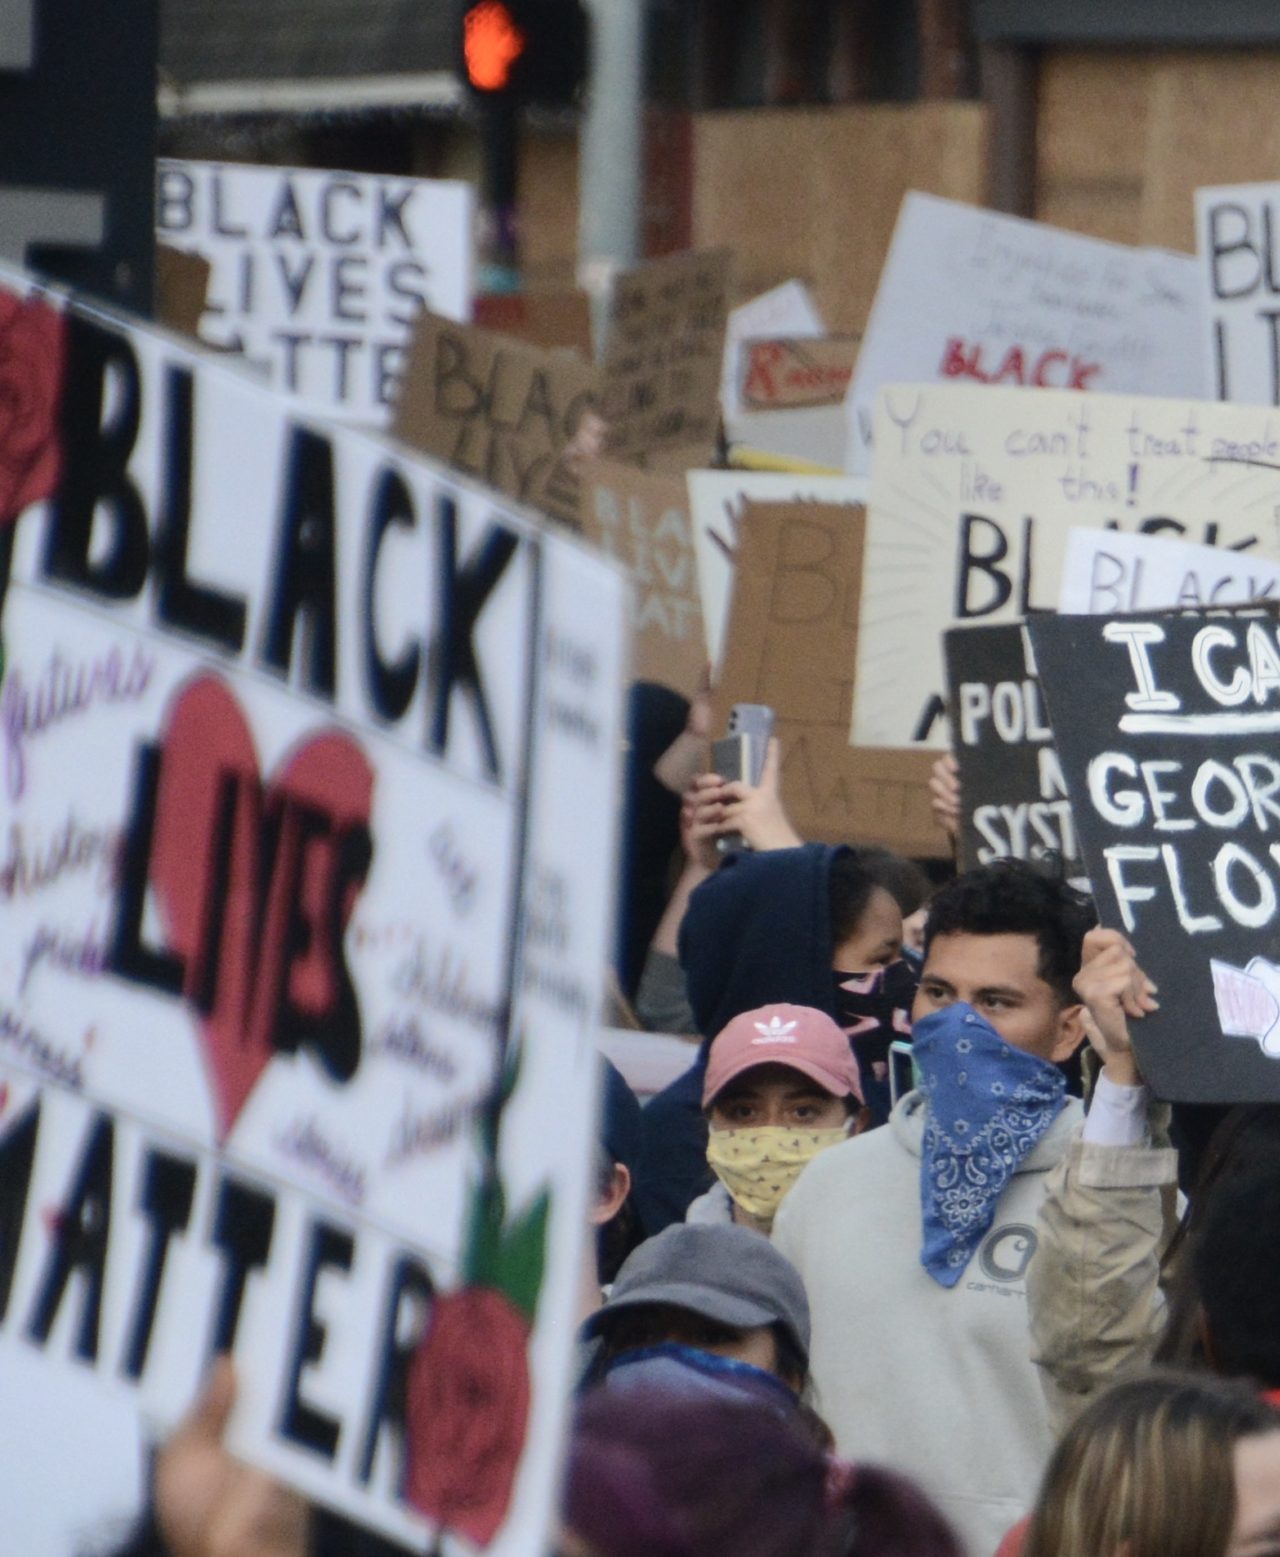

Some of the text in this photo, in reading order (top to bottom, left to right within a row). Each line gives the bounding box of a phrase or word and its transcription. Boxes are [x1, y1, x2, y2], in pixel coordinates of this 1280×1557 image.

[158, 168, 420, 252] BLACK
[206, 248, 430, 326] IVES
[434, 332, 608, 428] BLAC
[938, 336, 1104, 392] BLACK
[886, 392, 972, 456] You
[1126, 406, 1199, 457] treat
[592, 484, 692, 545] BLA
[36, 310, 522, 788] BLACK
[1090, 550, 1280, 614] BLACK
[1102, 622, 1181, 712] I
[960, 680, 1056, 746] POL
[973, 800, 1078, 868] SYST
[966, 1282, 1027, 1298] carhart
